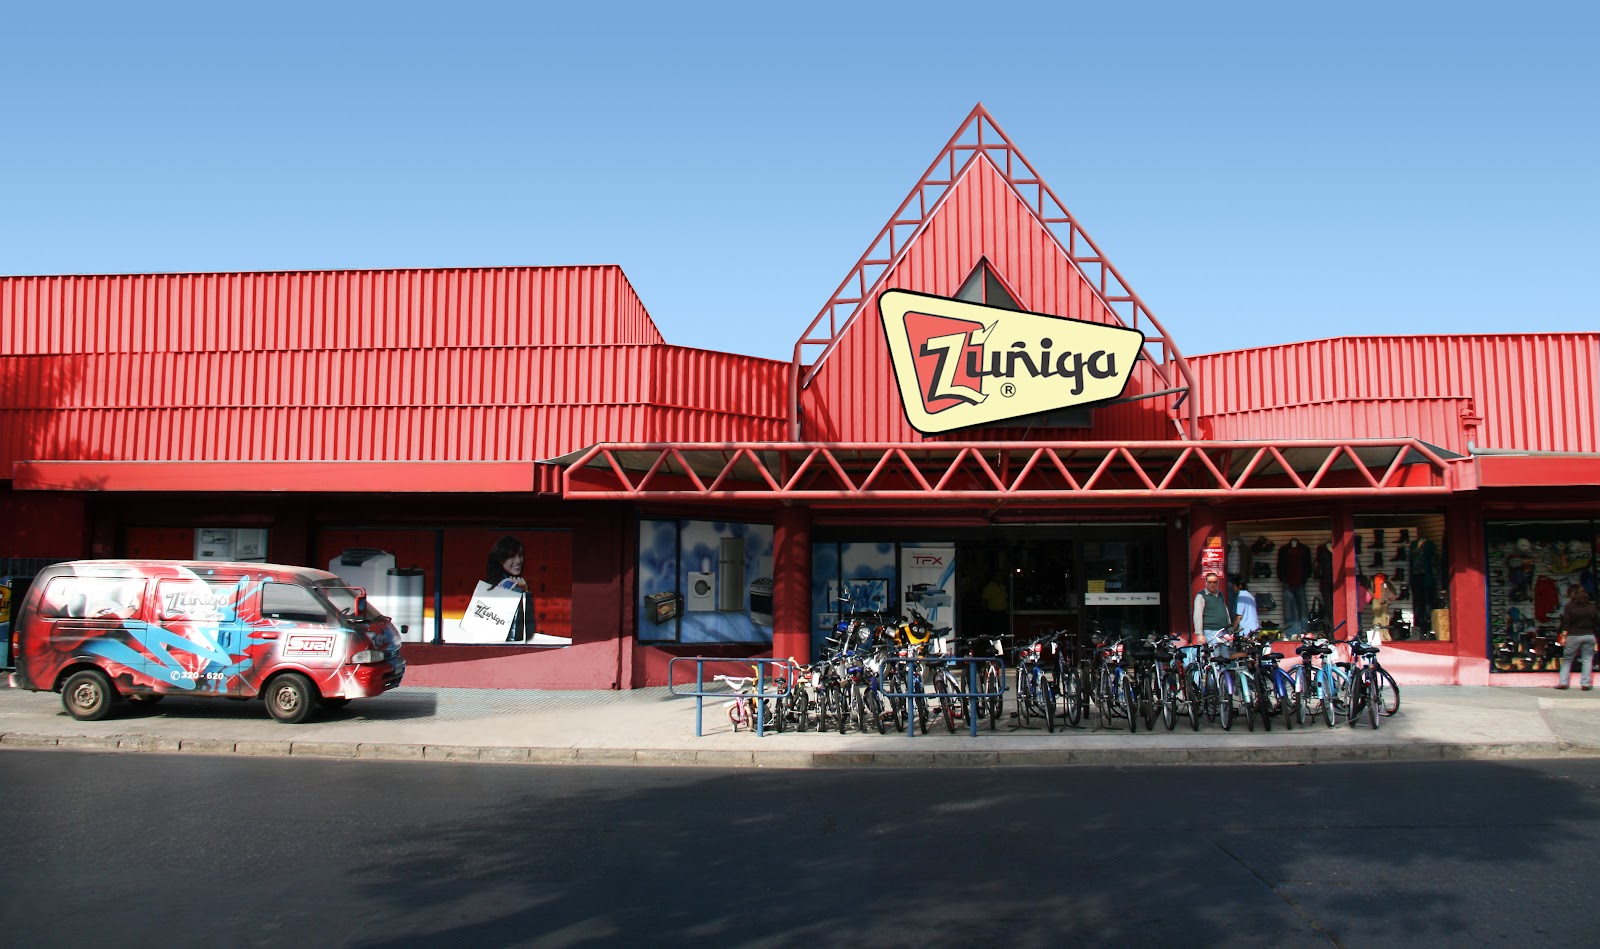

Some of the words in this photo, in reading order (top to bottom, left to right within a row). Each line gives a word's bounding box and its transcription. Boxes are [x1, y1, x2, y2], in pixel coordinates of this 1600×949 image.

[912, 556, 943, 565] TFX
[181, 671, 199, 679] 320
[206, 672, 224, 680] 620
